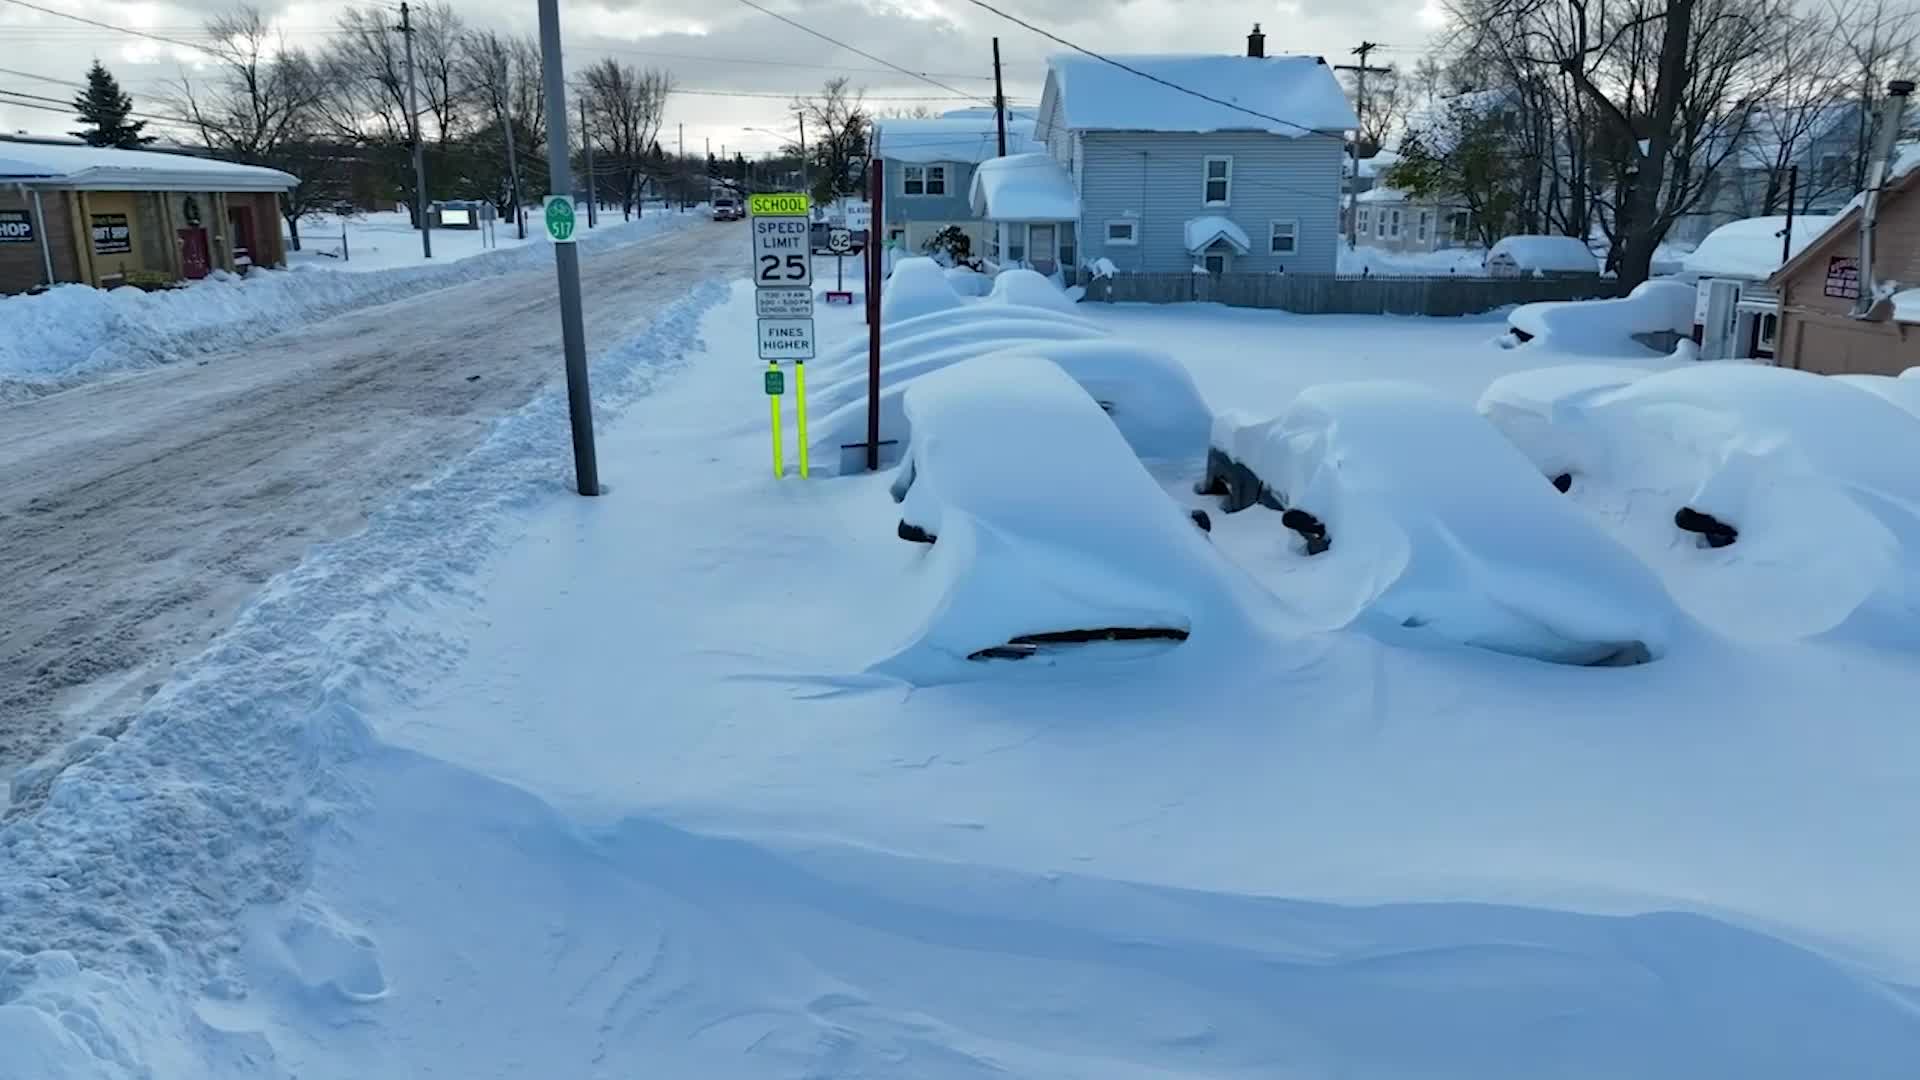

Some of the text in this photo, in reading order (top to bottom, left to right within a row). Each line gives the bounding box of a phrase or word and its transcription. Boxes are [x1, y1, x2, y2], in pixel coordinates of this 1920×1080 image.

[755, 199, 805, 212] SCHOOL
[0, 223, 31, 237] HOP
[552, 222, 572, 236] 517
[758, 222, 806, 234] SPEED
[763, 237, 801, 249] LIMIT
[831, 234, 849, 247] 62
[760, 254, 806, 280] 25
[768, 328, 804, 337] FINES
[763, 340, 809, 350] HIGHER
